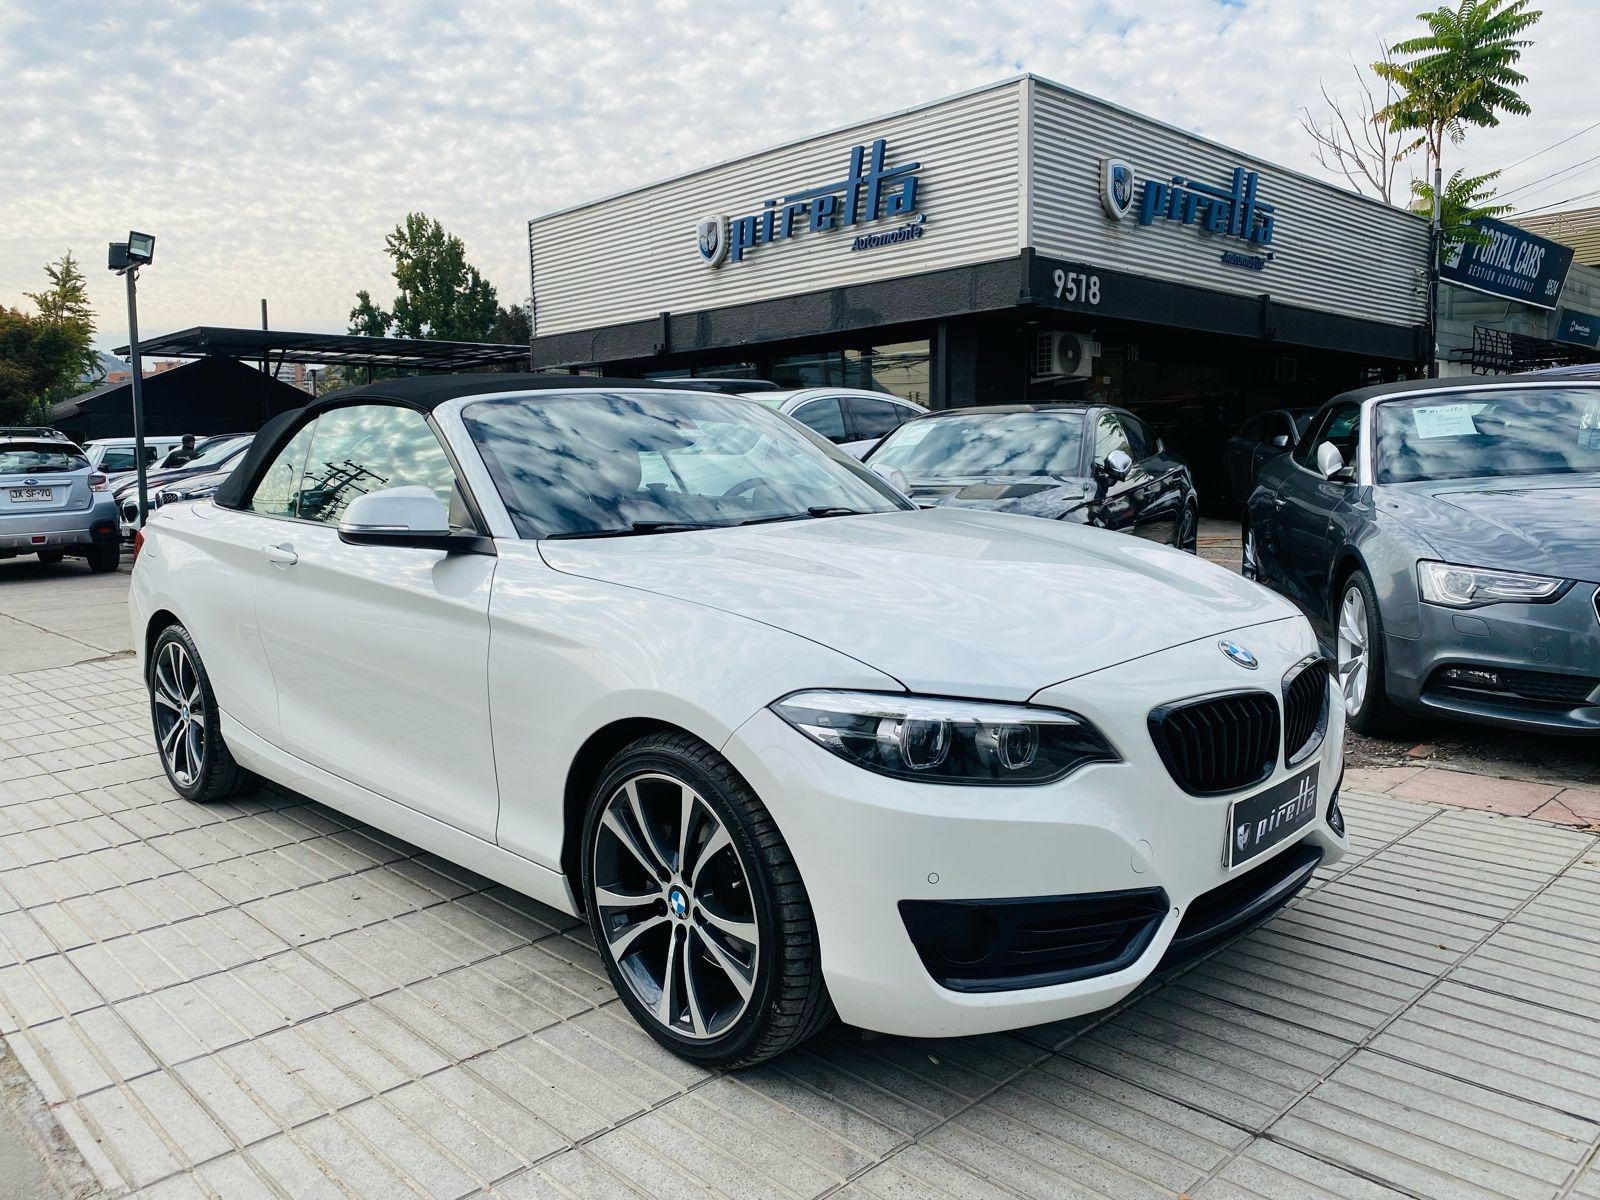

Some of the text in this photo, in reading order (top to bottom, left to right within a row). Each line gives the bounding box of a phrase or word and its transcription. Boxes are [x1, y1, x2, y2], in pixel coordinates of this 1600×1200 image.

[852, 223, 923, 251] Automobile
[1472, 226, 1546, 279] PORTAL CARS
[1053, 269, 1100, 305] 9518
